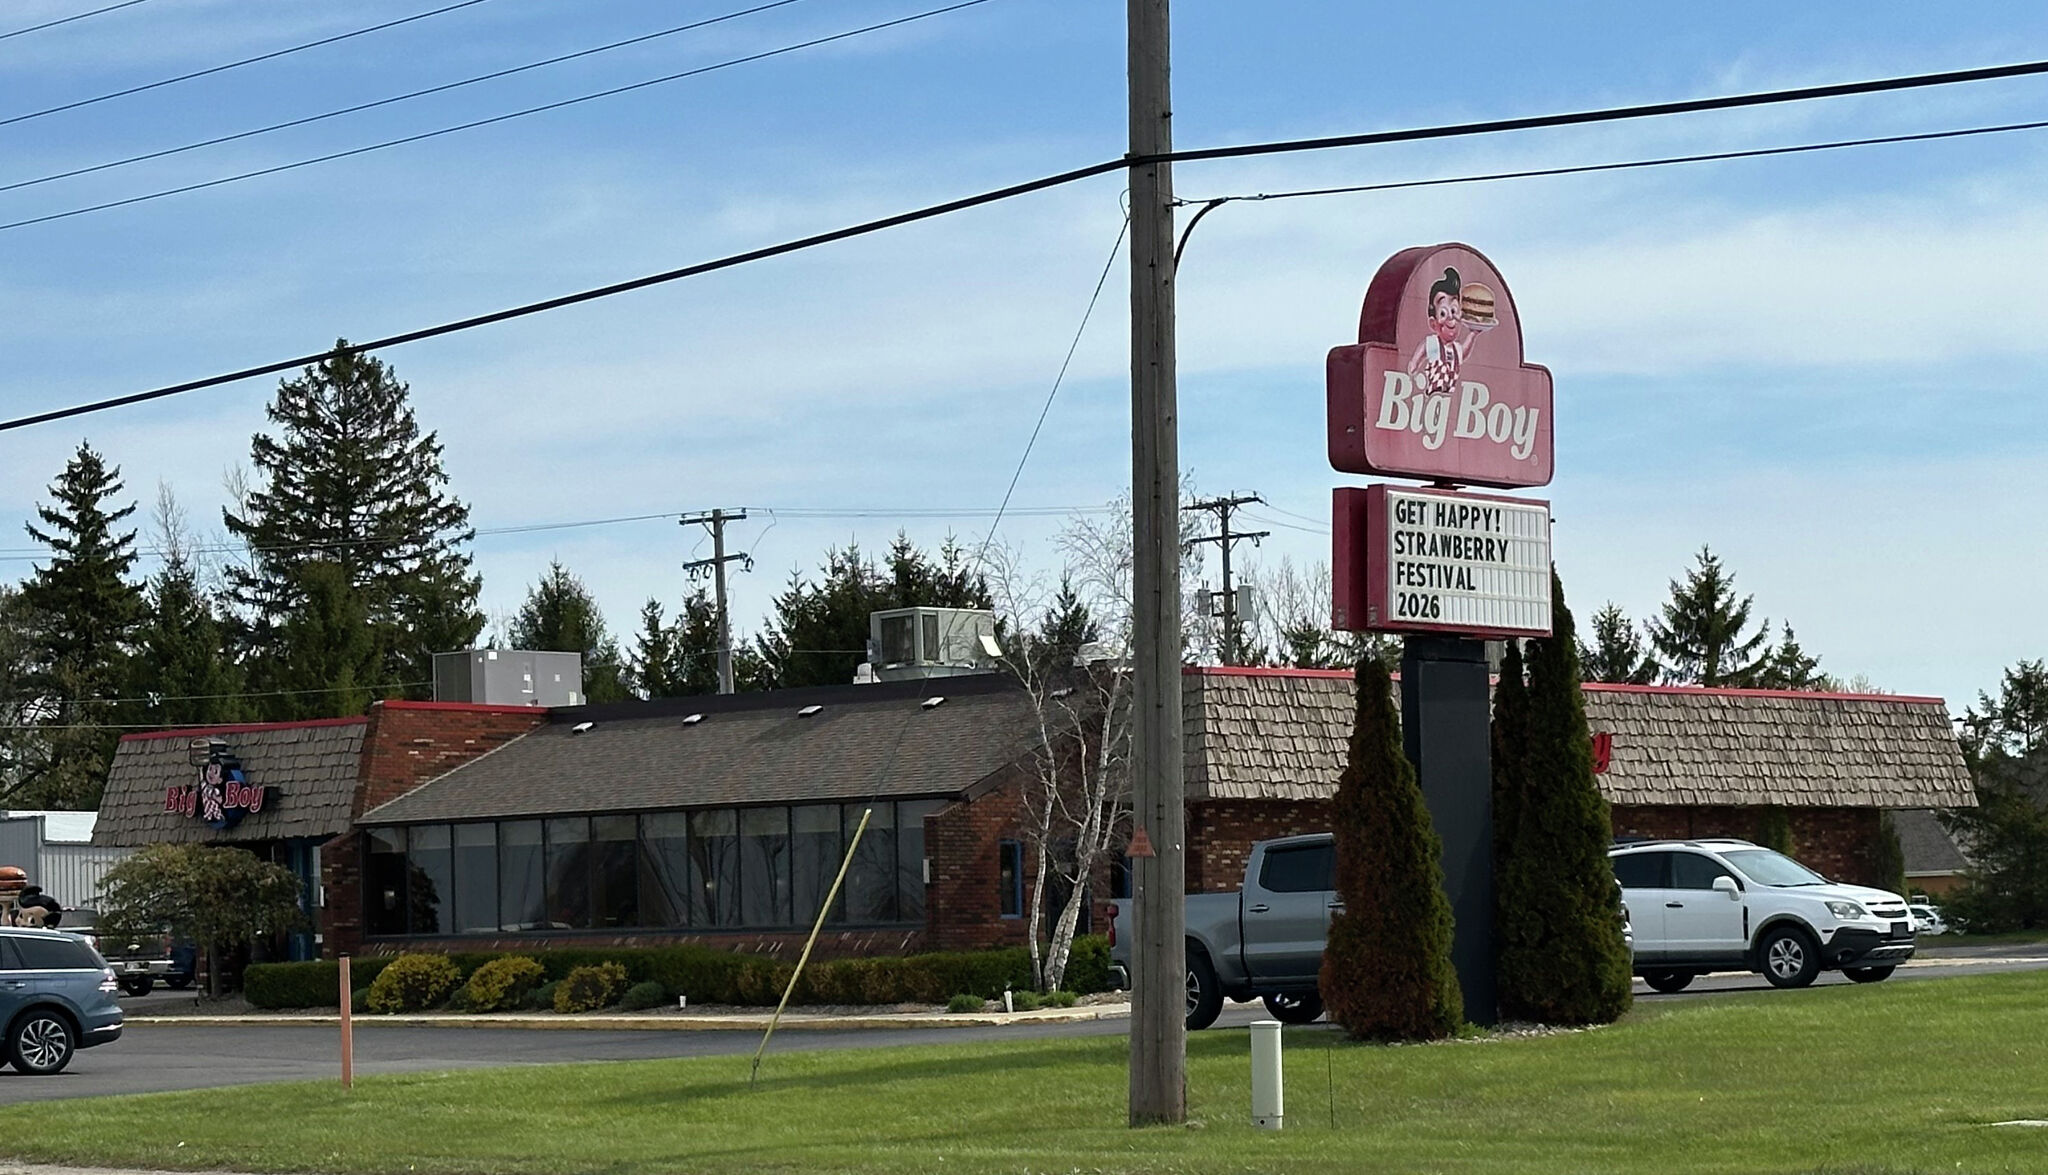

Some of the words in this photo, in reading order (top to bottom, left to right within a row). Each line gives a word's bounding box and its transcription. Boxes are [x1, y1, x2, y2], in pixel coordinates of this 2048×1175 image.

[1376, 371, 1450, 450] Big
[1453, 381, 1540, 460] Boy
[1396, 499, 1427, 525] GET
[1436, 503, 1501, 532] HAPPY!
[1395, 530, 1509, 563] STRAWBERRY
[1397, 561, 1476, 590] FESTIVAL
[1398, 592, 1440, 619] 2026
[164, 786, 197, 817] Big
[223, 781, 265, 813] Boy
